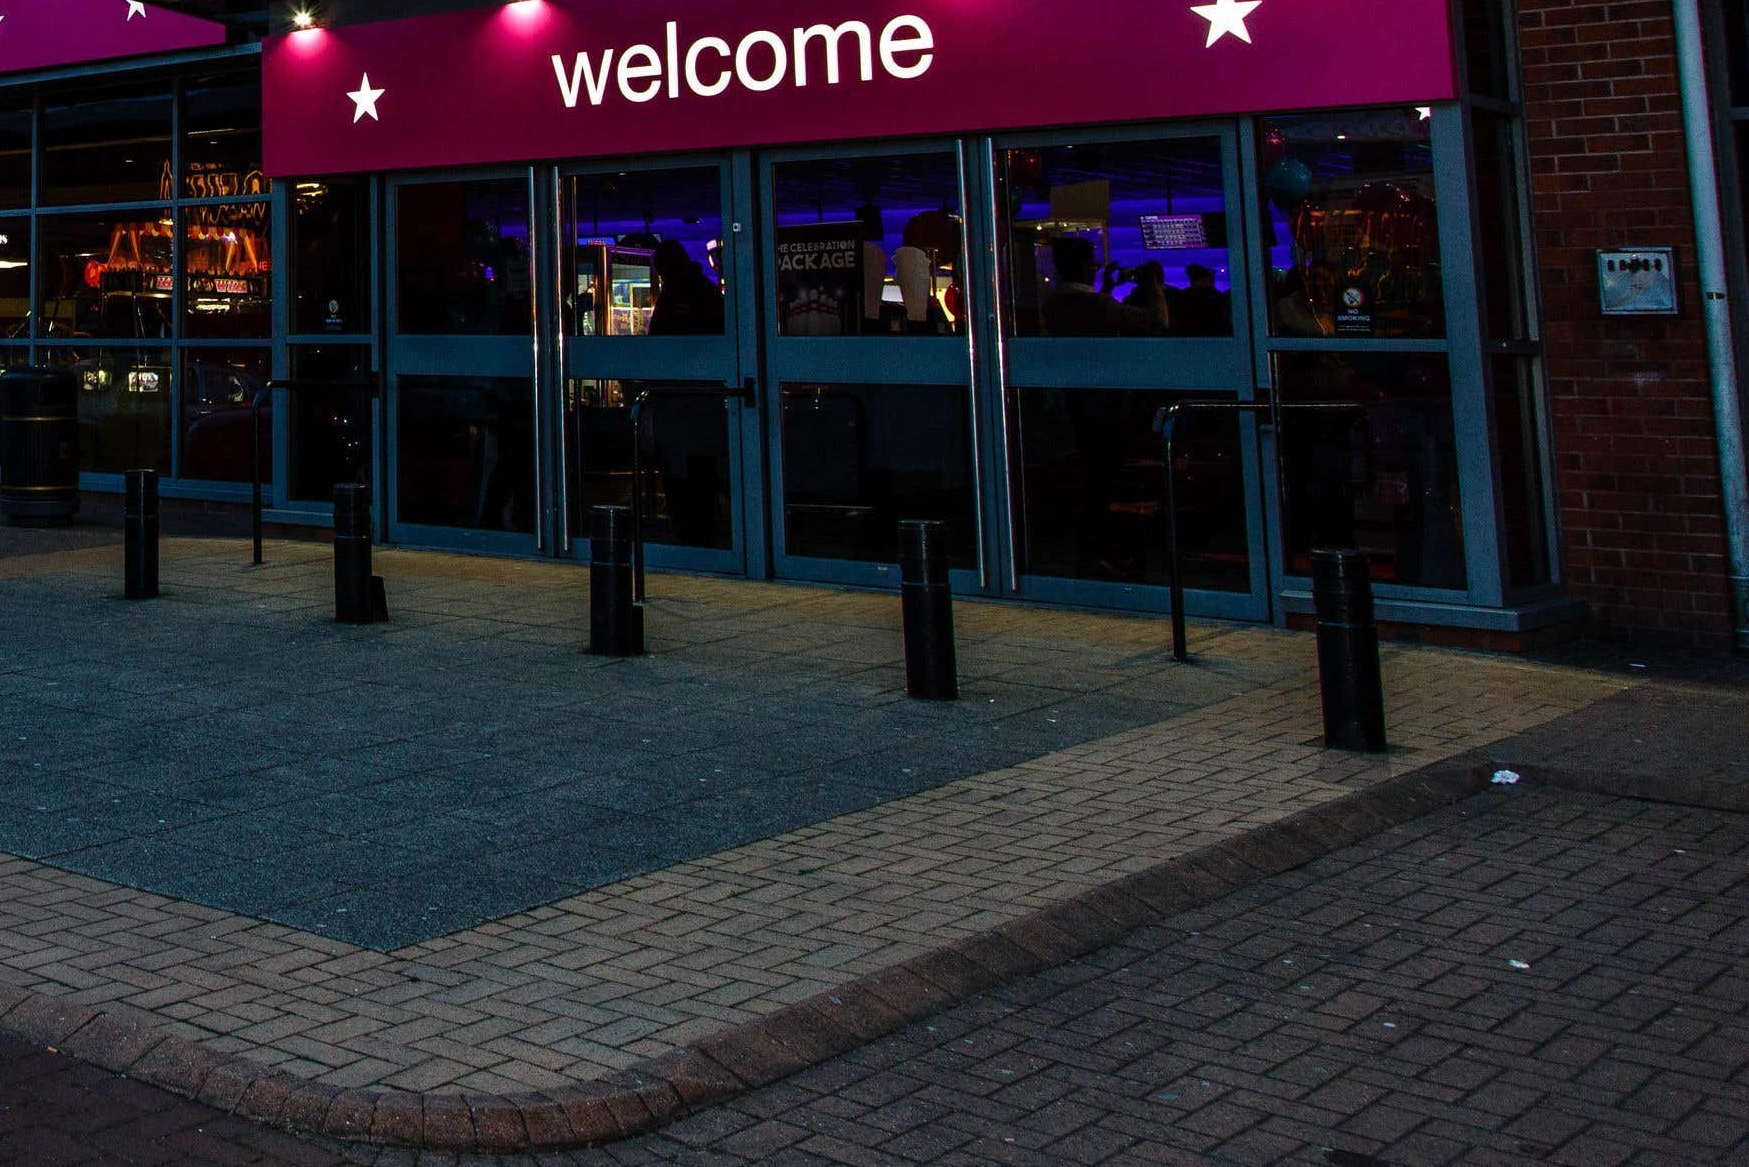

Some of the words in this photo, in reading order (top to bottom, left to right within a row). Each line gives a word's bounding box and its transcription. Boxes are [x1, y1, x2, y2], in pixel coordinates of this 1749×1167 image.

[551, 14, 935, 108] welcome
[790, 239, 855, 252] CELEBRATION
[778, 251, 856, 272] ACKAGE
